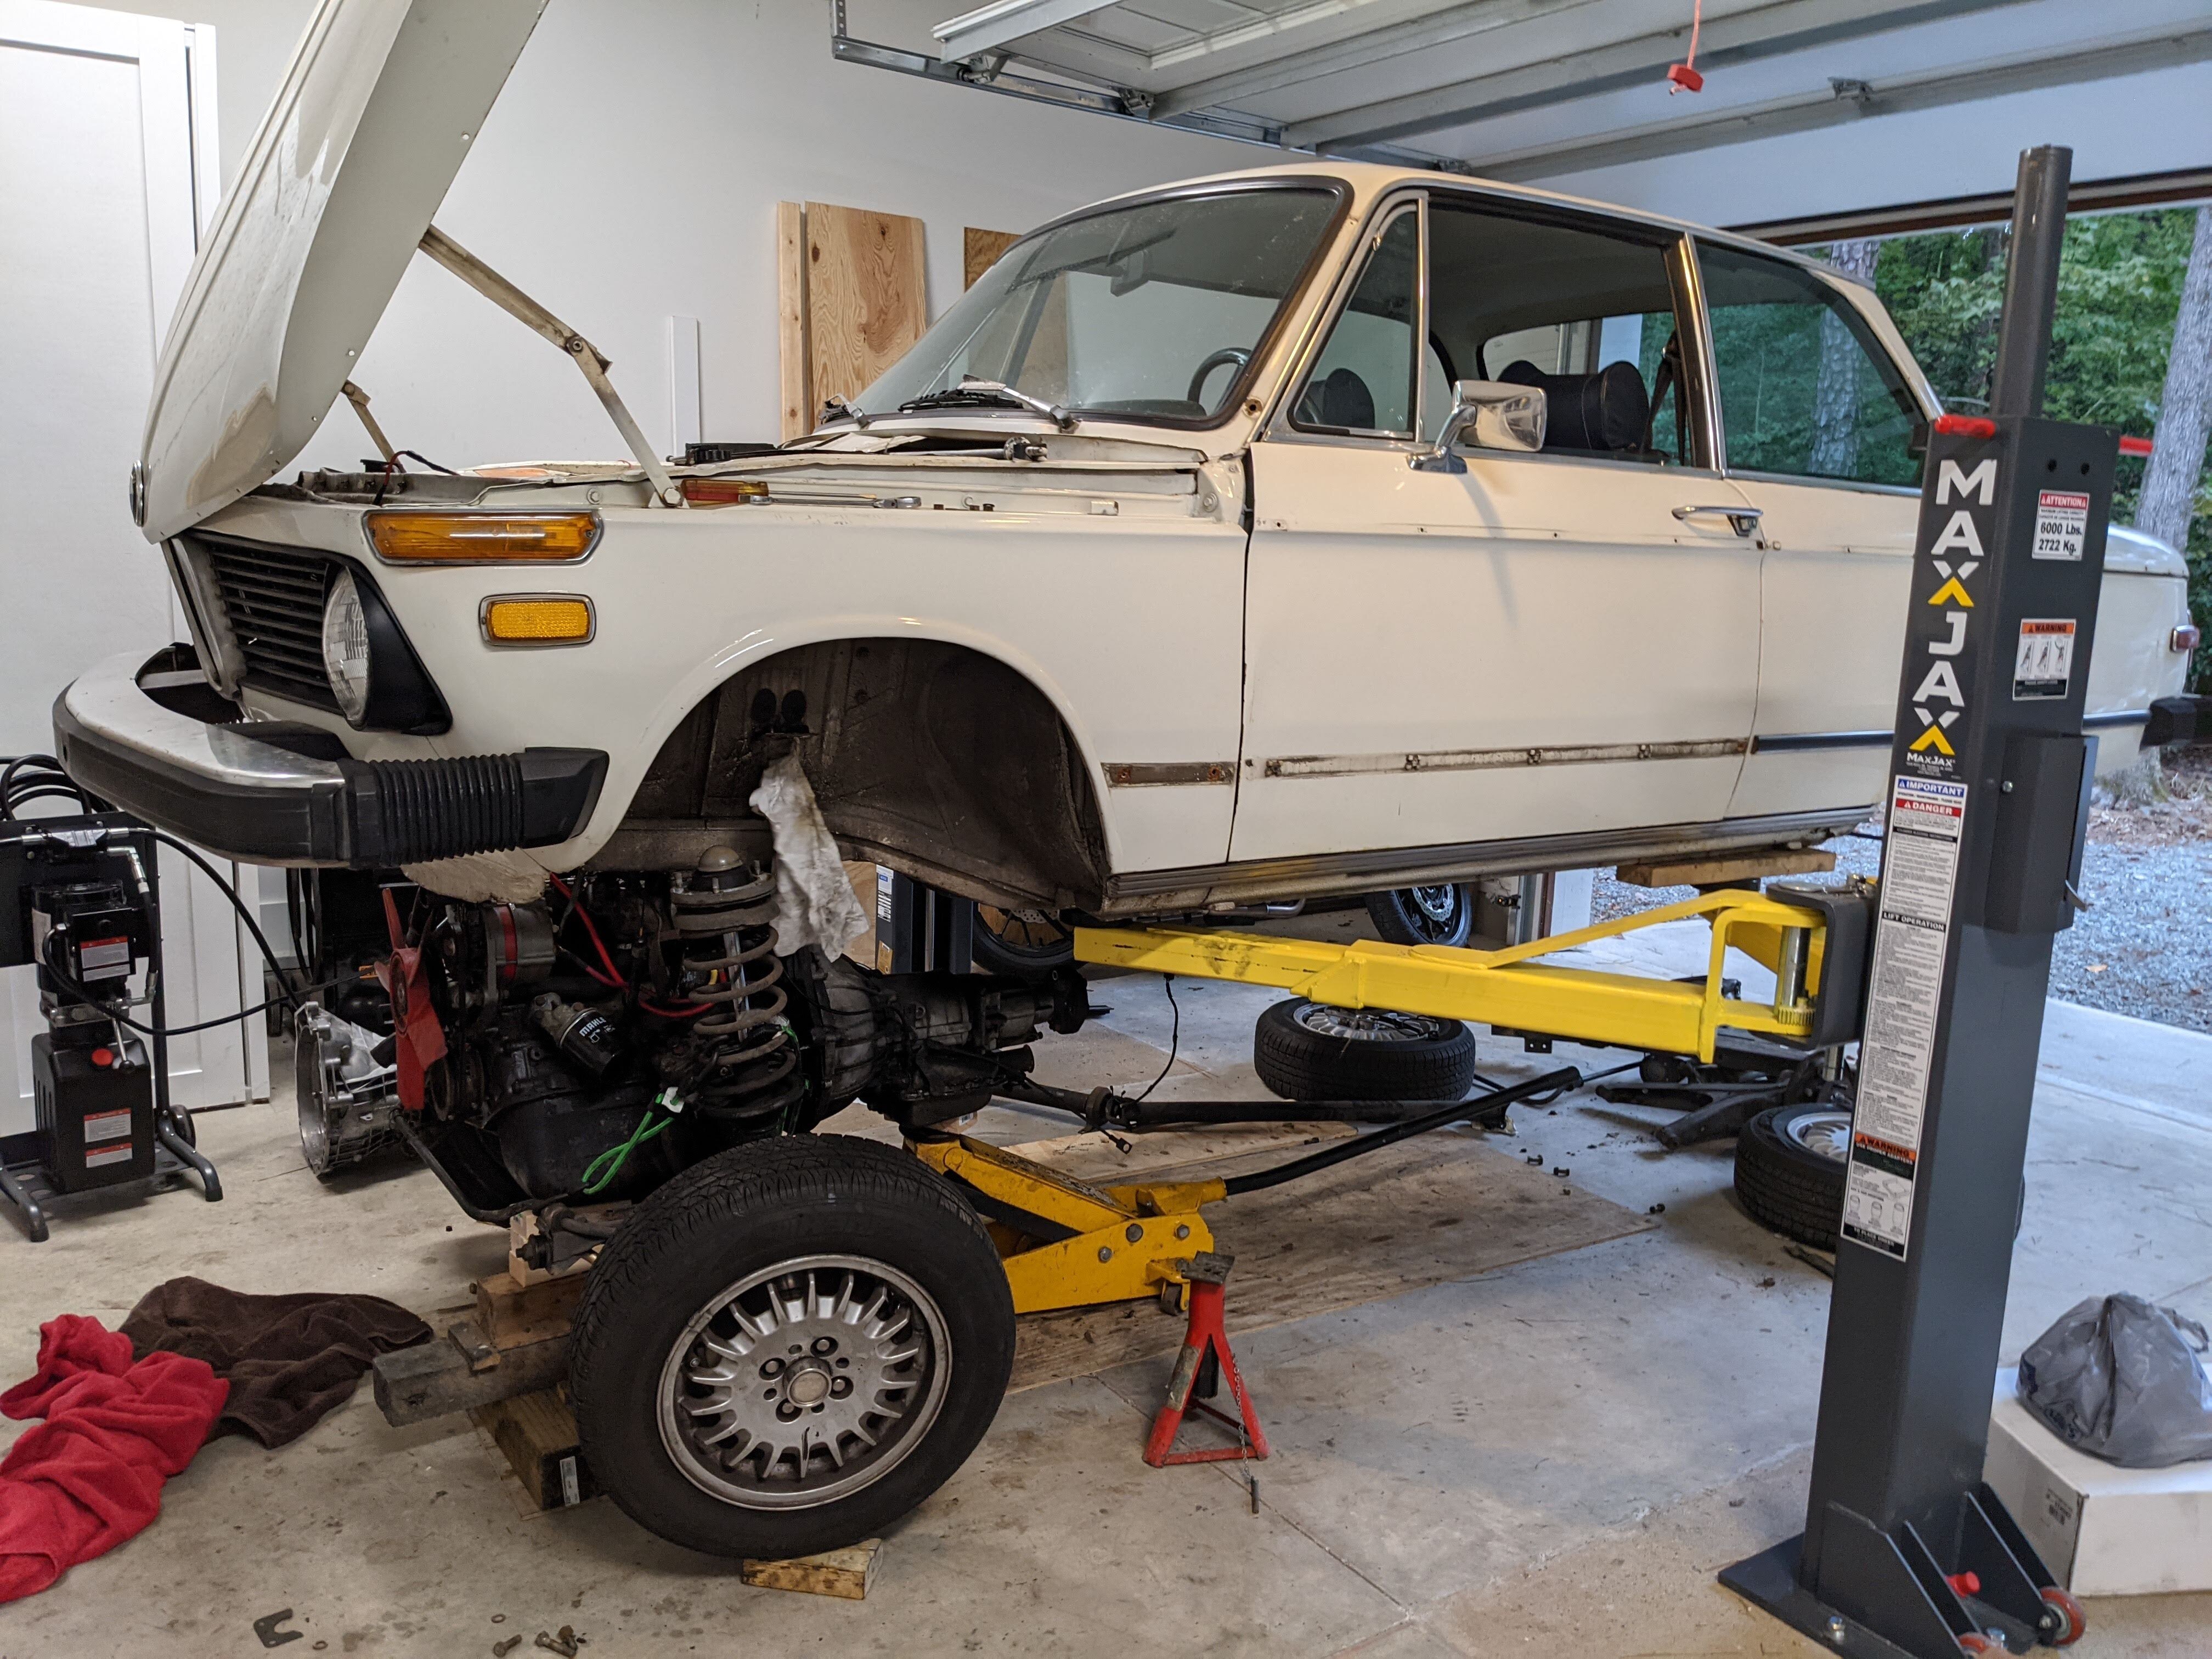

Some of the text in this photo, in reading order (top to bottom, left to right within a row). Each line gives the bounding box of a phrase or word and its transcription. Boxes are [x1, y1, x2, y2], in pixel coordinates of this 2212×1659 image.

[2046, 495, 2082, 507] ATTENTION
[2040, 522, 2082, 535] 6000 Lbs.
[2038, 539, 2076, 556] 2722 Kg.
[2035, 623, 2067, 633] WARNING
[1906, 780, 1963, 797] IMPORTANT
[1912, 802, 1953, 815] DANGER
[1883, 912, 1944, 930] LIFT OPERATION
[579, 1017, 606, 1037] MAHLE
[1867, 1137, 1910, 1158] WARNING
